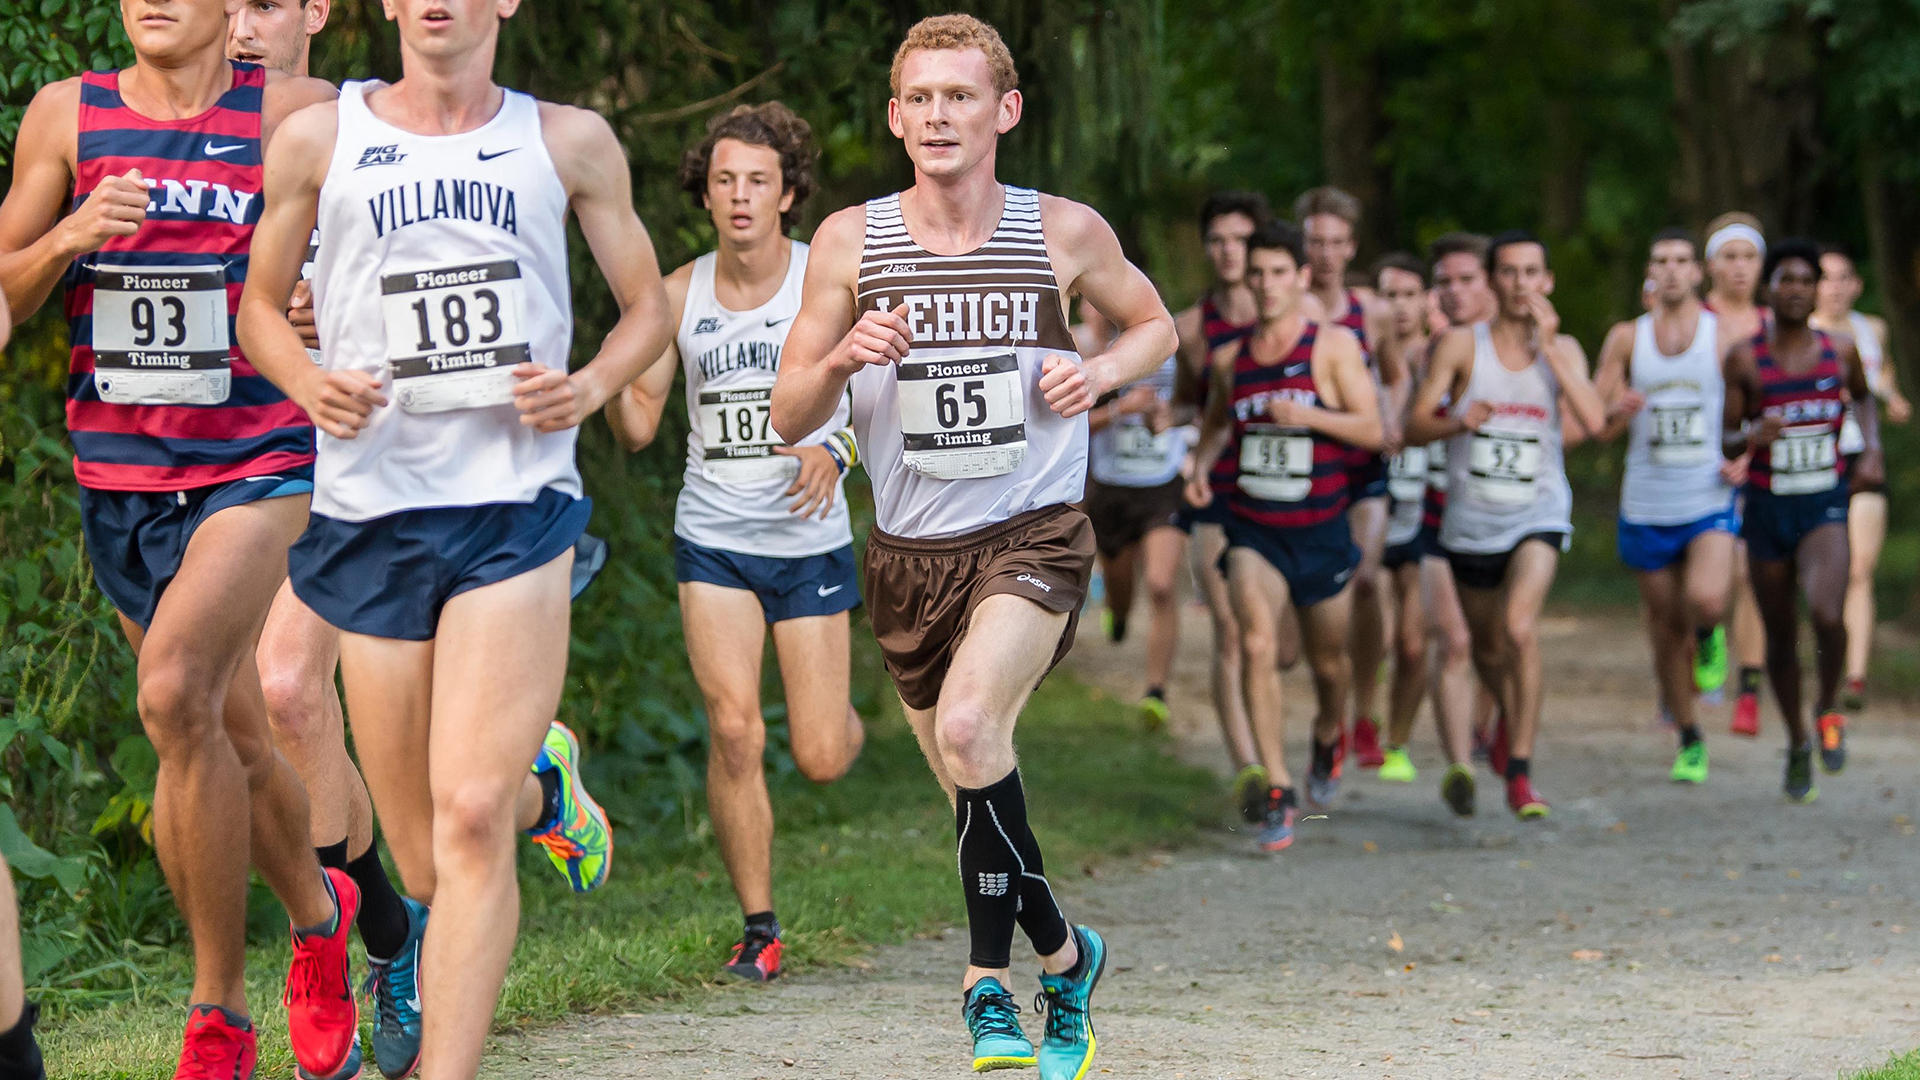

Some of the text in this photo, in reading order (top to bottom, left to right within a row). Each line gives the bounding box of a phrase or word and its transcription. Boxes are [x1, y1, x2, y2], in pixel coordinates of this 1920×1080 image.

[363, 144, 399, 155] BIG
[358, 153, 408, 165] EAST
[368, 178, 517, 239] VILLANOVA
[892, 264, 917, 273] asics
[122, 275, 191, 290] Pioneer
[415, 268, 488, 289] Pioneer
[131, 296, 187, 347] 93
[411, 288, 503, 351] 183
[128, 352, 191, 369] Timing
[427, 350, 497, 371] Timing
[926, 363, 989, 378] Pioneer
[719, 391, 766, 403] Pioneer
[935, 380, 988, 429] 65
[717, 406, 770, 443] 187
[933, 432, 992, 446] Timing
[724, 446, 770, 457] Timing
[1029, 578, 1051, 592] asics
[979, 888, 1007, 897] cep
